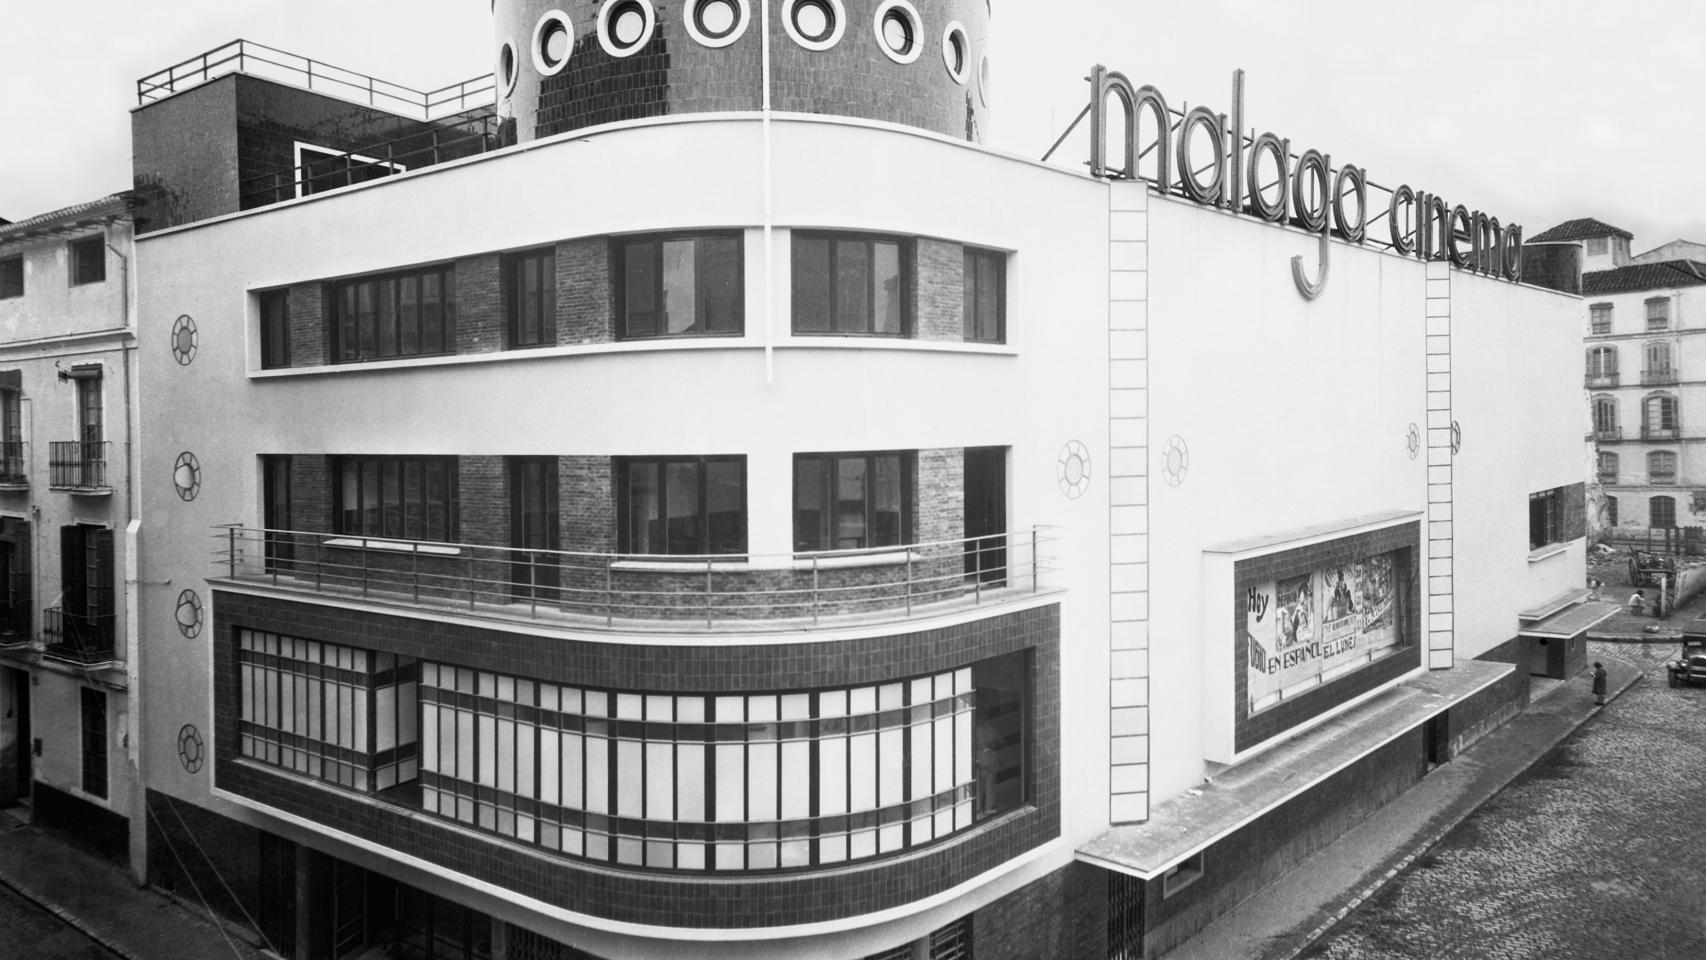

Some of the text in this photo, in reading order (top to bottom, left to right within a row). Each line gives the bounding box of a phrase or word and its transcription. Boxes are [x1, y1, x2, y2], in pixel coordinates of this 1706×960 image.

[1090, 64, 1523, 301] malaga cinema
[1247, 586, 1269, 623] Hoy
[1268, 656, 1281, 675] EN
[1323, 644, 1335, 660] EL
